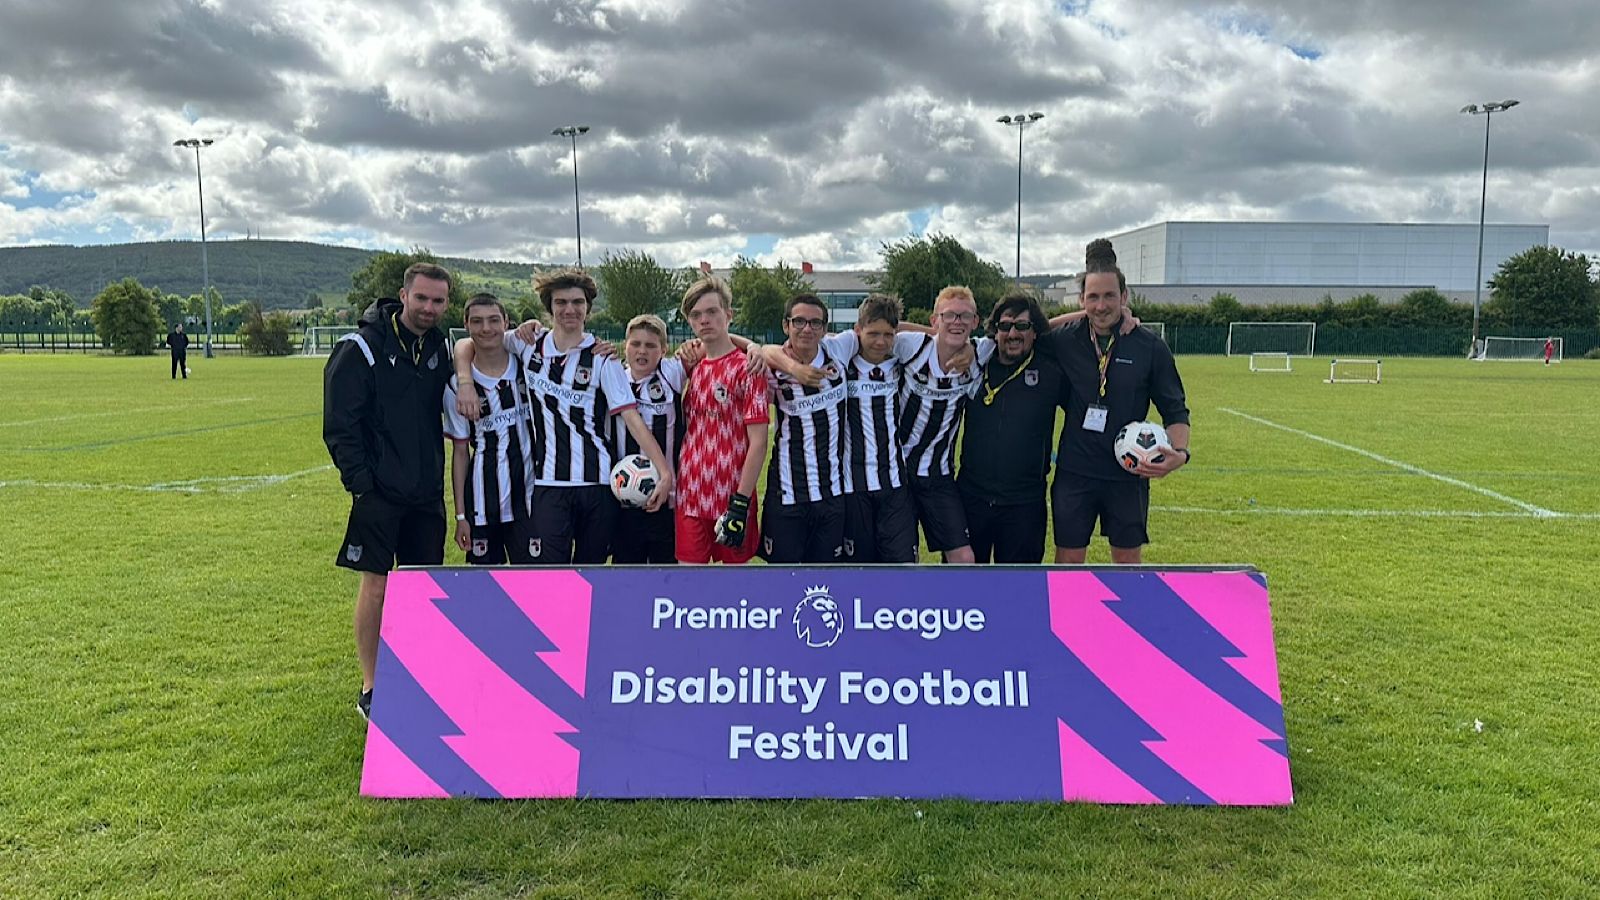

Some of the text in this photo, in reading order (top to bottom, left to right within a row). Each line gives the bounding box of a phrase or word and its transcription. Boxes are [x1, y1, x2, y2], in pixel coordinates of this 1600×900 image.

[652, 597, 986, 640] Premier League
[611, 666, 1029, 714] Disability Football
[729, 721, 908, 761] Festival
